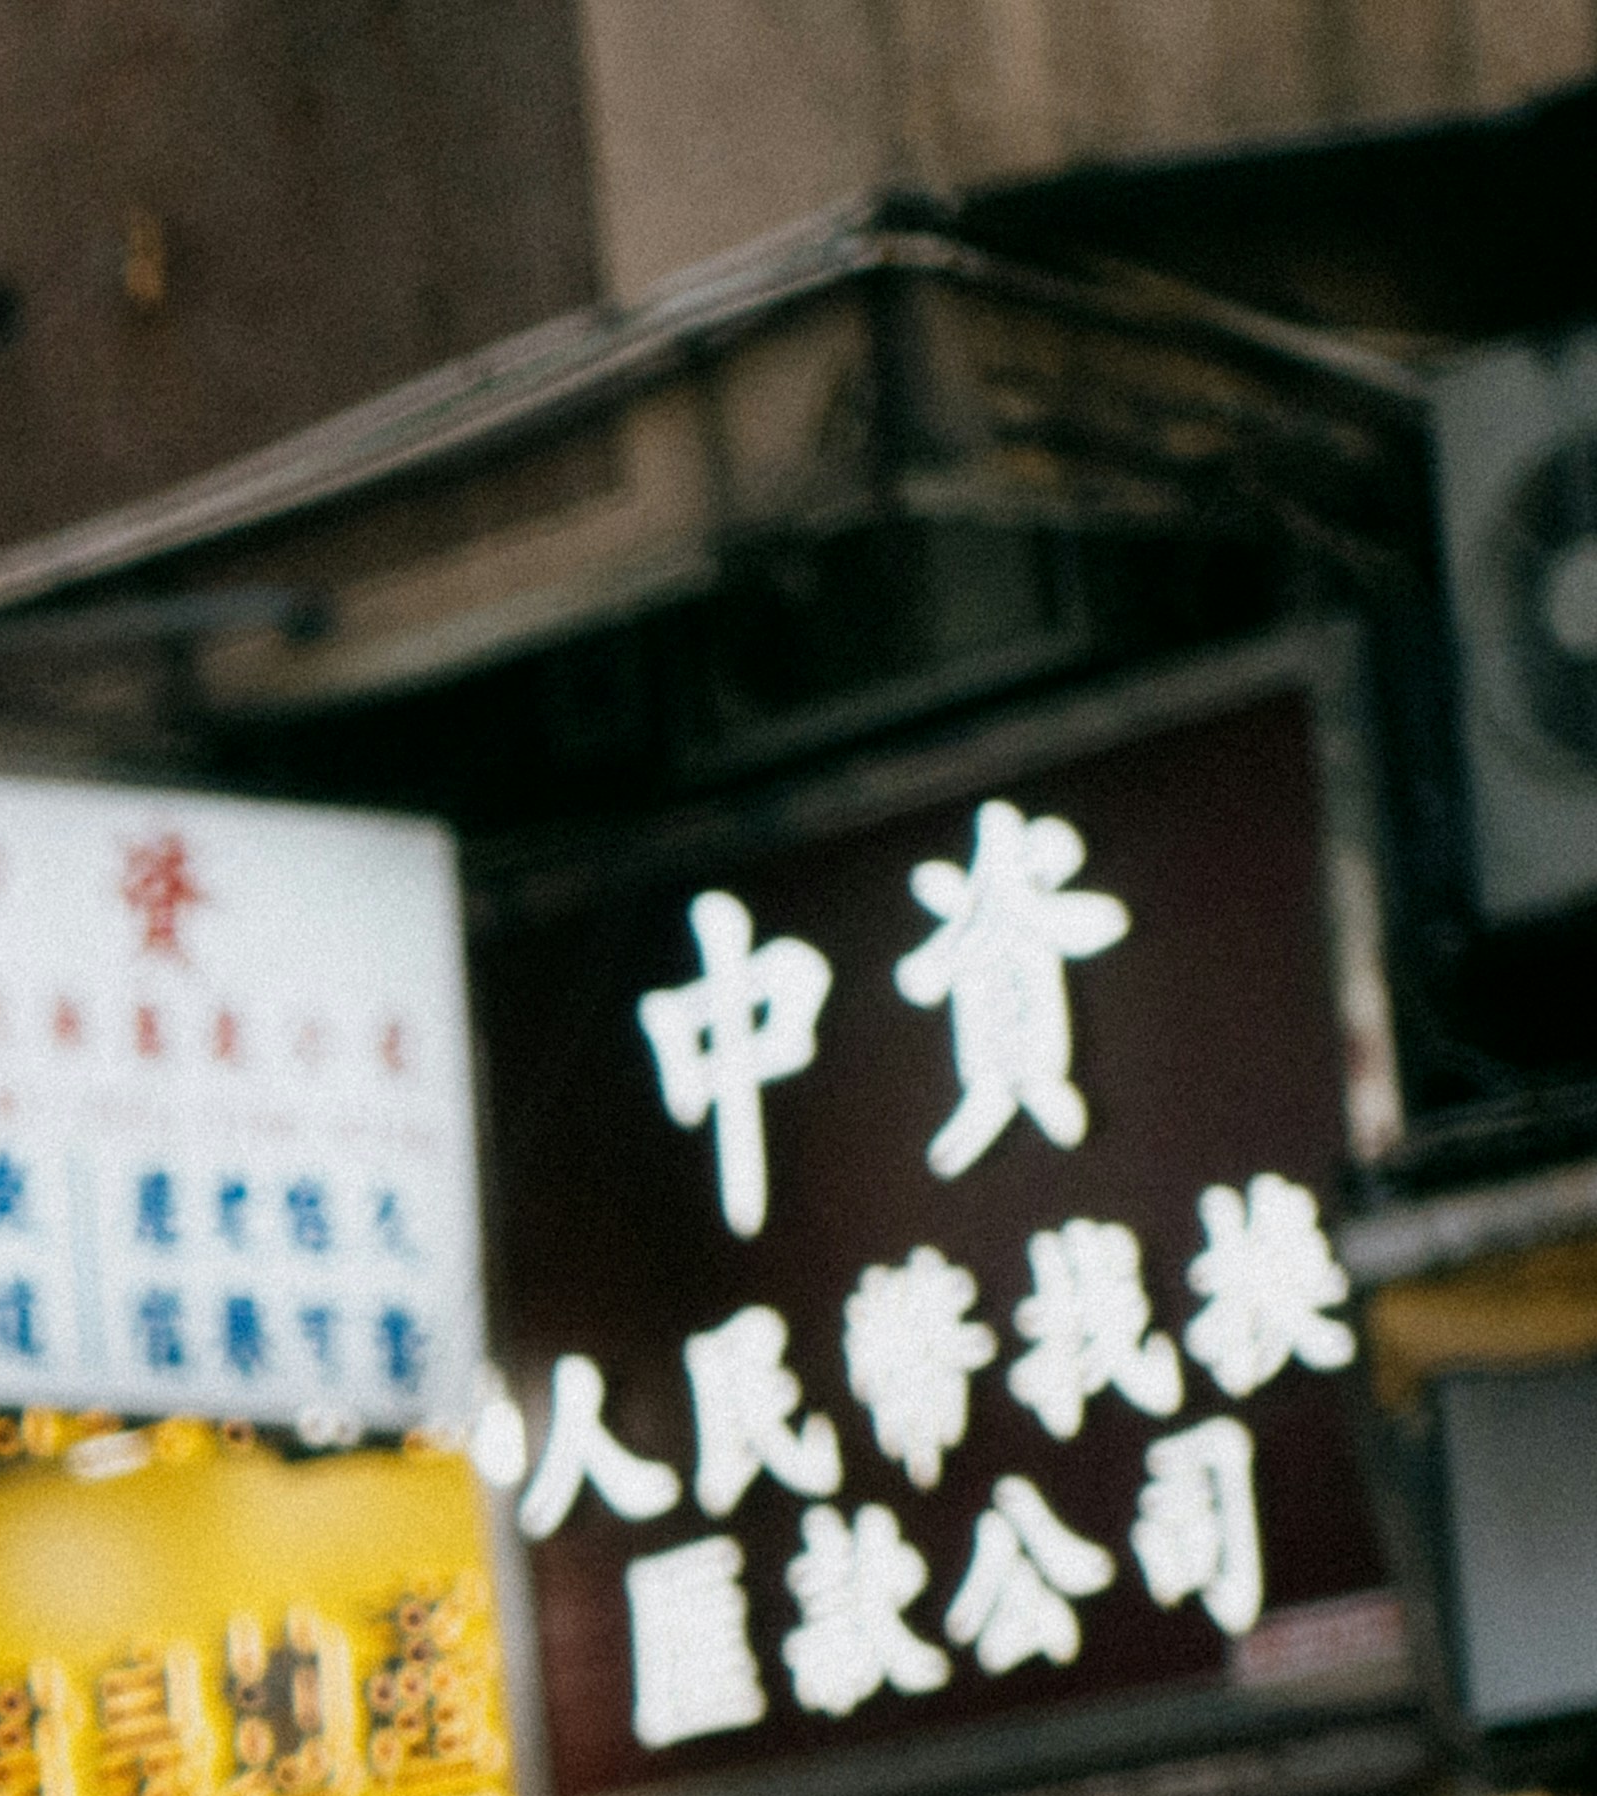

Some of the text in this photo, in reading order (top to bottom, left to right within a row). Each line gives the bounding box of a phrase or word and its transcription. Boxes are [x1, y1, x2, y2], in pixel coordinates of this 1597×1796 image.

[638, 800, 1131, 1240] 中資
[518, 1172, 1356, 1540] 人民幣找換
[626, 1417, 1264, 1748] 匯款公司
